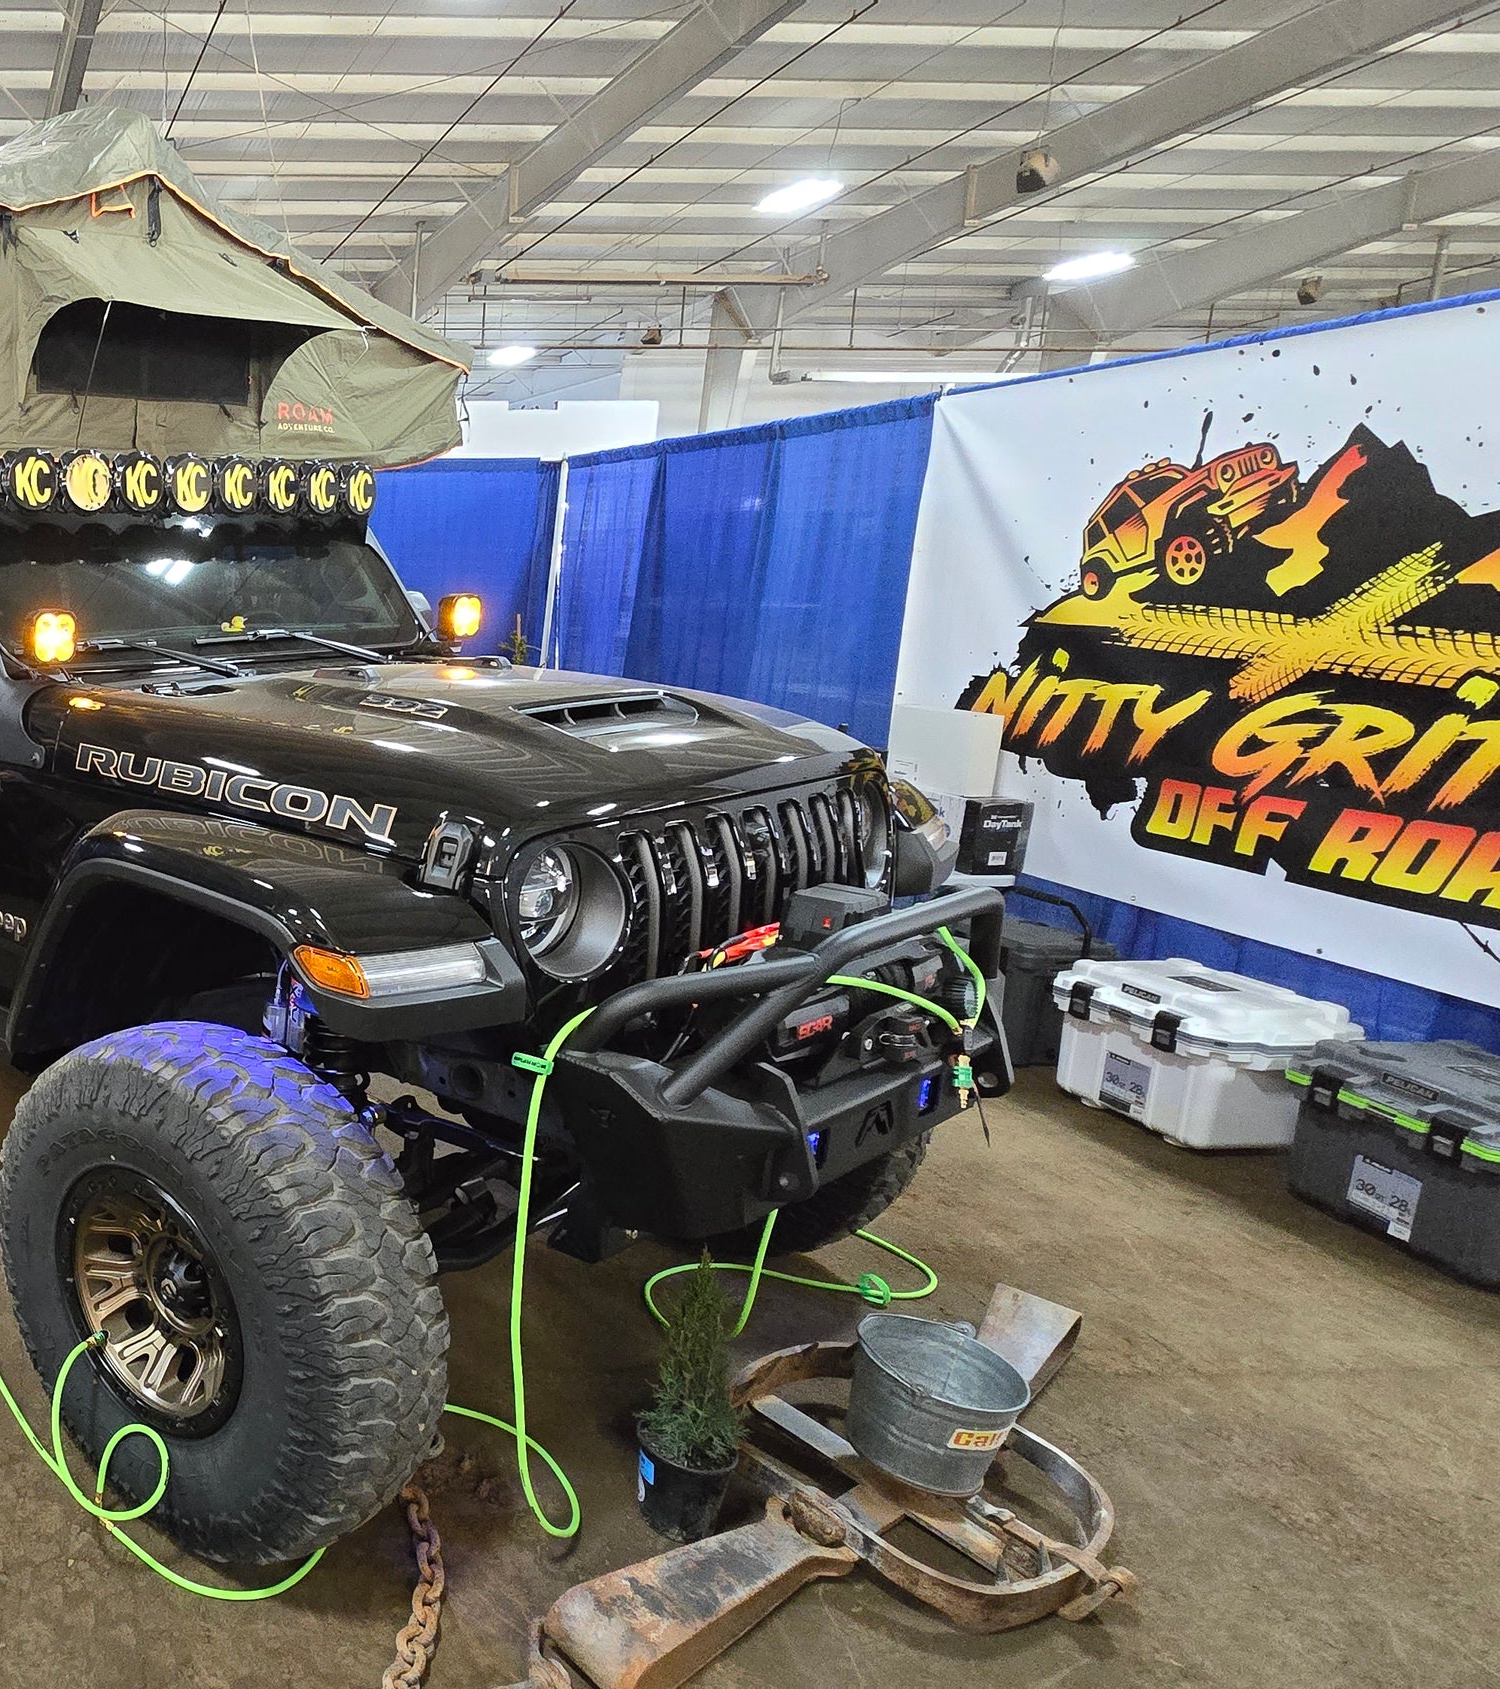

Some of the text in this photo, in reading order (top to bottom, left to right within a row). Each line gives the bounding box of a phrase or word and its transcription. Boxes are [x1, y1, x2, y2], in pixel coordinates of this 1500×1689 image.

[277, 402, 334, 425] ROAM
[277, 423, 323, 433] ADVENTURE
[15, 456, 51, 507] KC
[126, 460, 158, 508] KC
[176, 461, 207, 509] KC
[225, 464, 253, 509] KC
[269, 465, 296, 510] KC
[311, 468, 335, 511] KC
[349, 470, 372, 512] KC
[75, 742, 398, 839] RUBICON
[983, 819, 1022, 830] DayTank
[1145, 778, 1305, 856] OFF
[1124, 986, 1158, 1003] PELICAN
[1385, 1075, 1435, 1099] PELICAN
